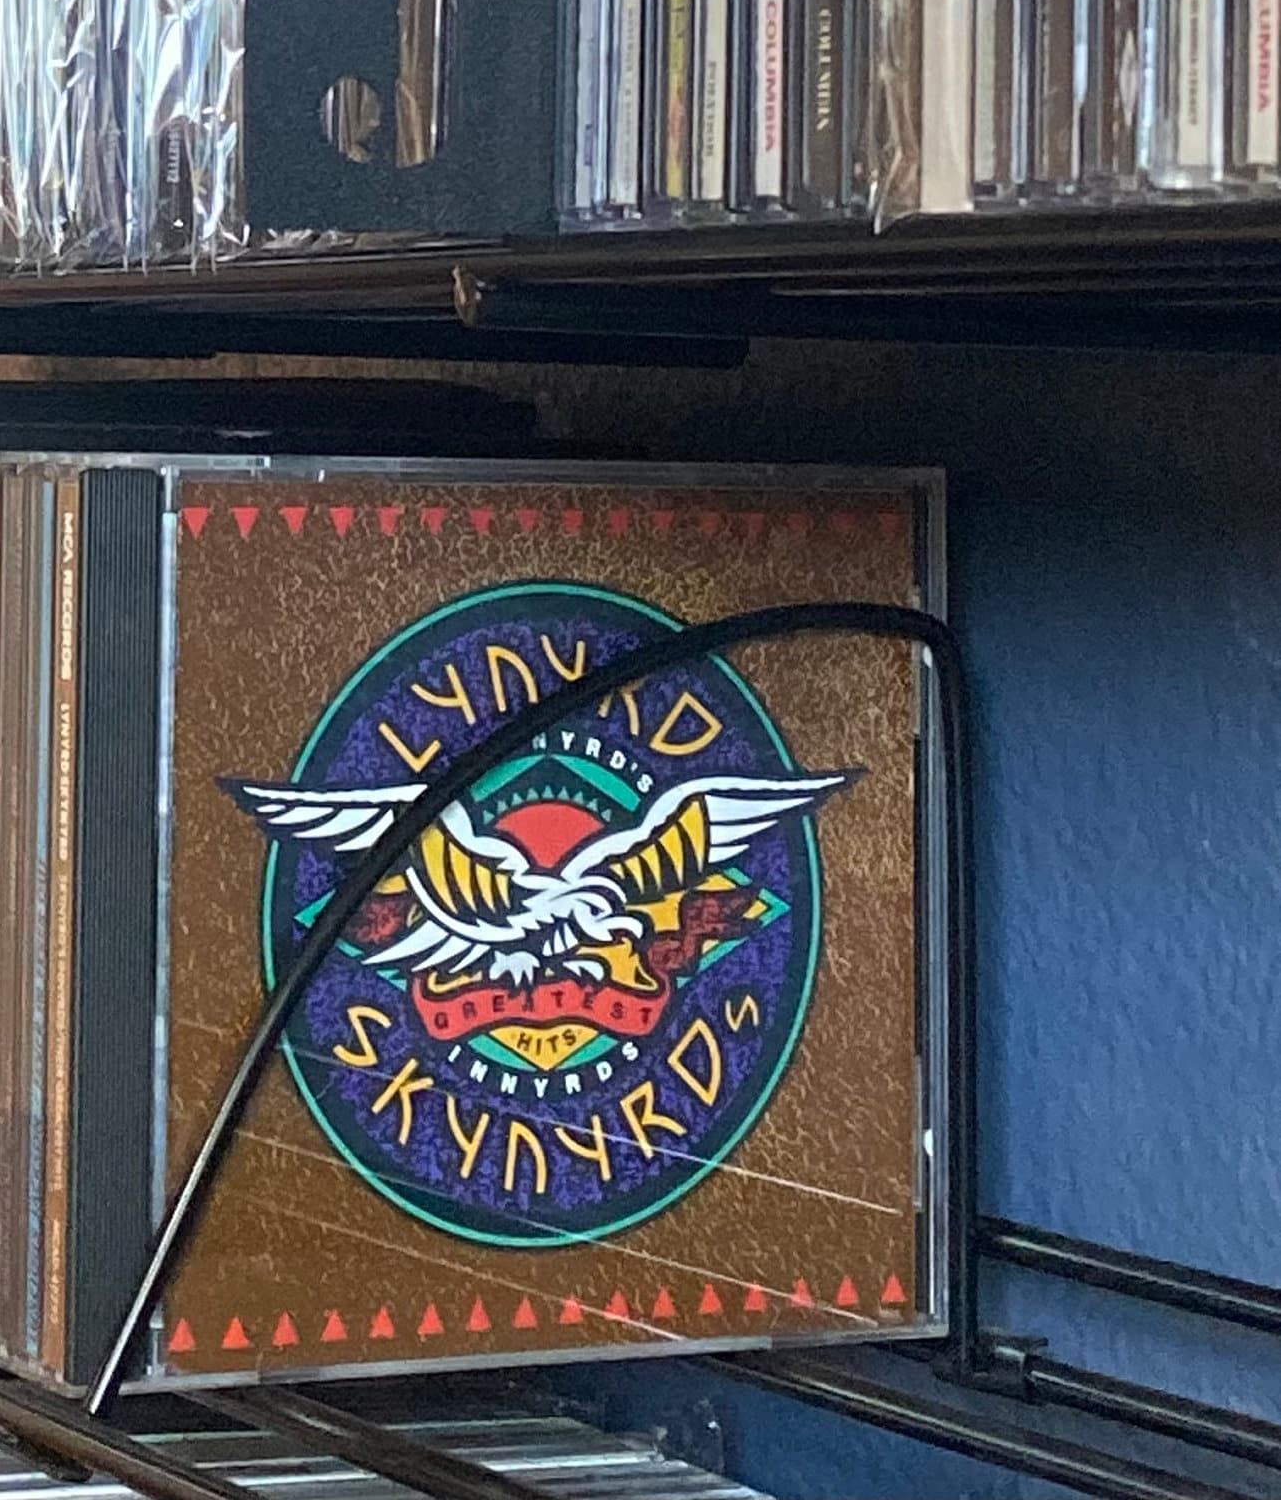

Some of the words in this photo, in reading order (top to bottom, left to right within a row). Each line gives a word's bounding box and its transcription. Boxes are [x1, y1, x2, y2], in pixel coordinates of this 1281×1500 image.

[764, 0, 779, 153] COLUMBIA
[816, 6, 833, 133] COLUMBIA
[62, 512, 74, 563] MCA
[60, 569, 74, 680] RECORDS
[59, 703, 71, 773] LYNYRD
[531, 730, 655, 794] NYRD'S
[433, 987, 653, 1031] GREATEST
[447, 1041, 640, 1099] INNYRDS
[516, 1028, 578, 1057] HITS
